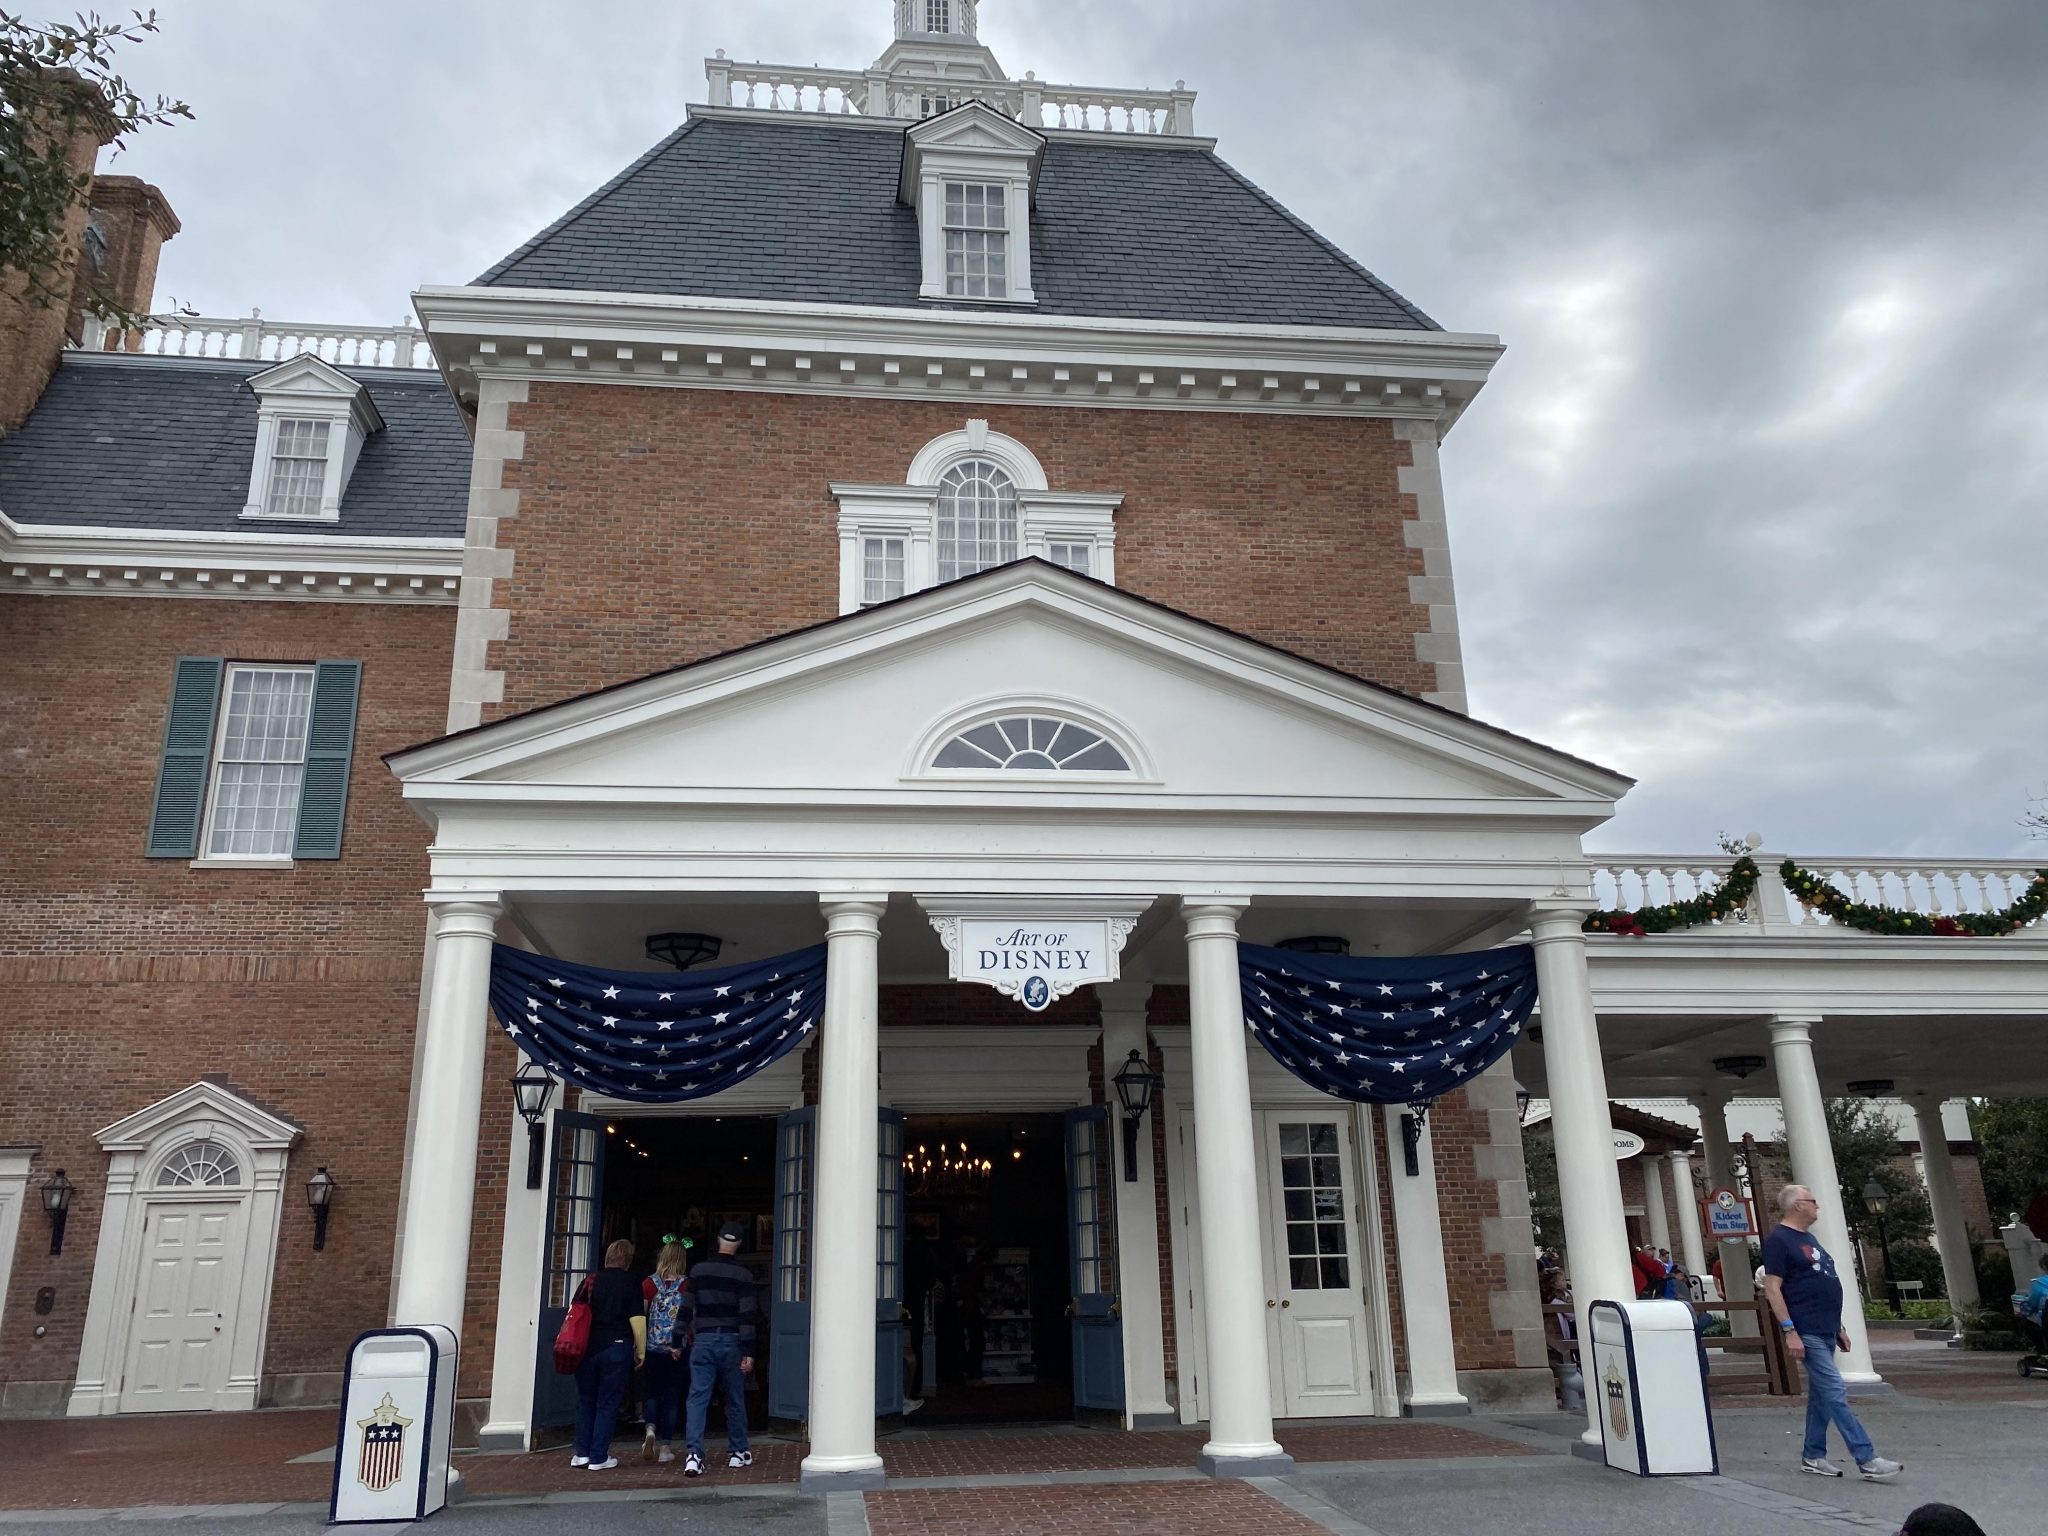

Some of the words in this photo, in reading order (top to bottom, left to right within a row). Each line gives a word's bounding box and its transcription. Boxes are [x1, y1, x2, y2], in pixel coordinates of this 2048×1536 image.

[1045, 933, 1068, 946] OF
[978, 950, 1091, 970] DISNEY
[1715, 1212, 1742, 1220] Kidcot
[1712, 1221, 1729, 1230] Fun
[1730, 1220, 1748, 1231] Stop
